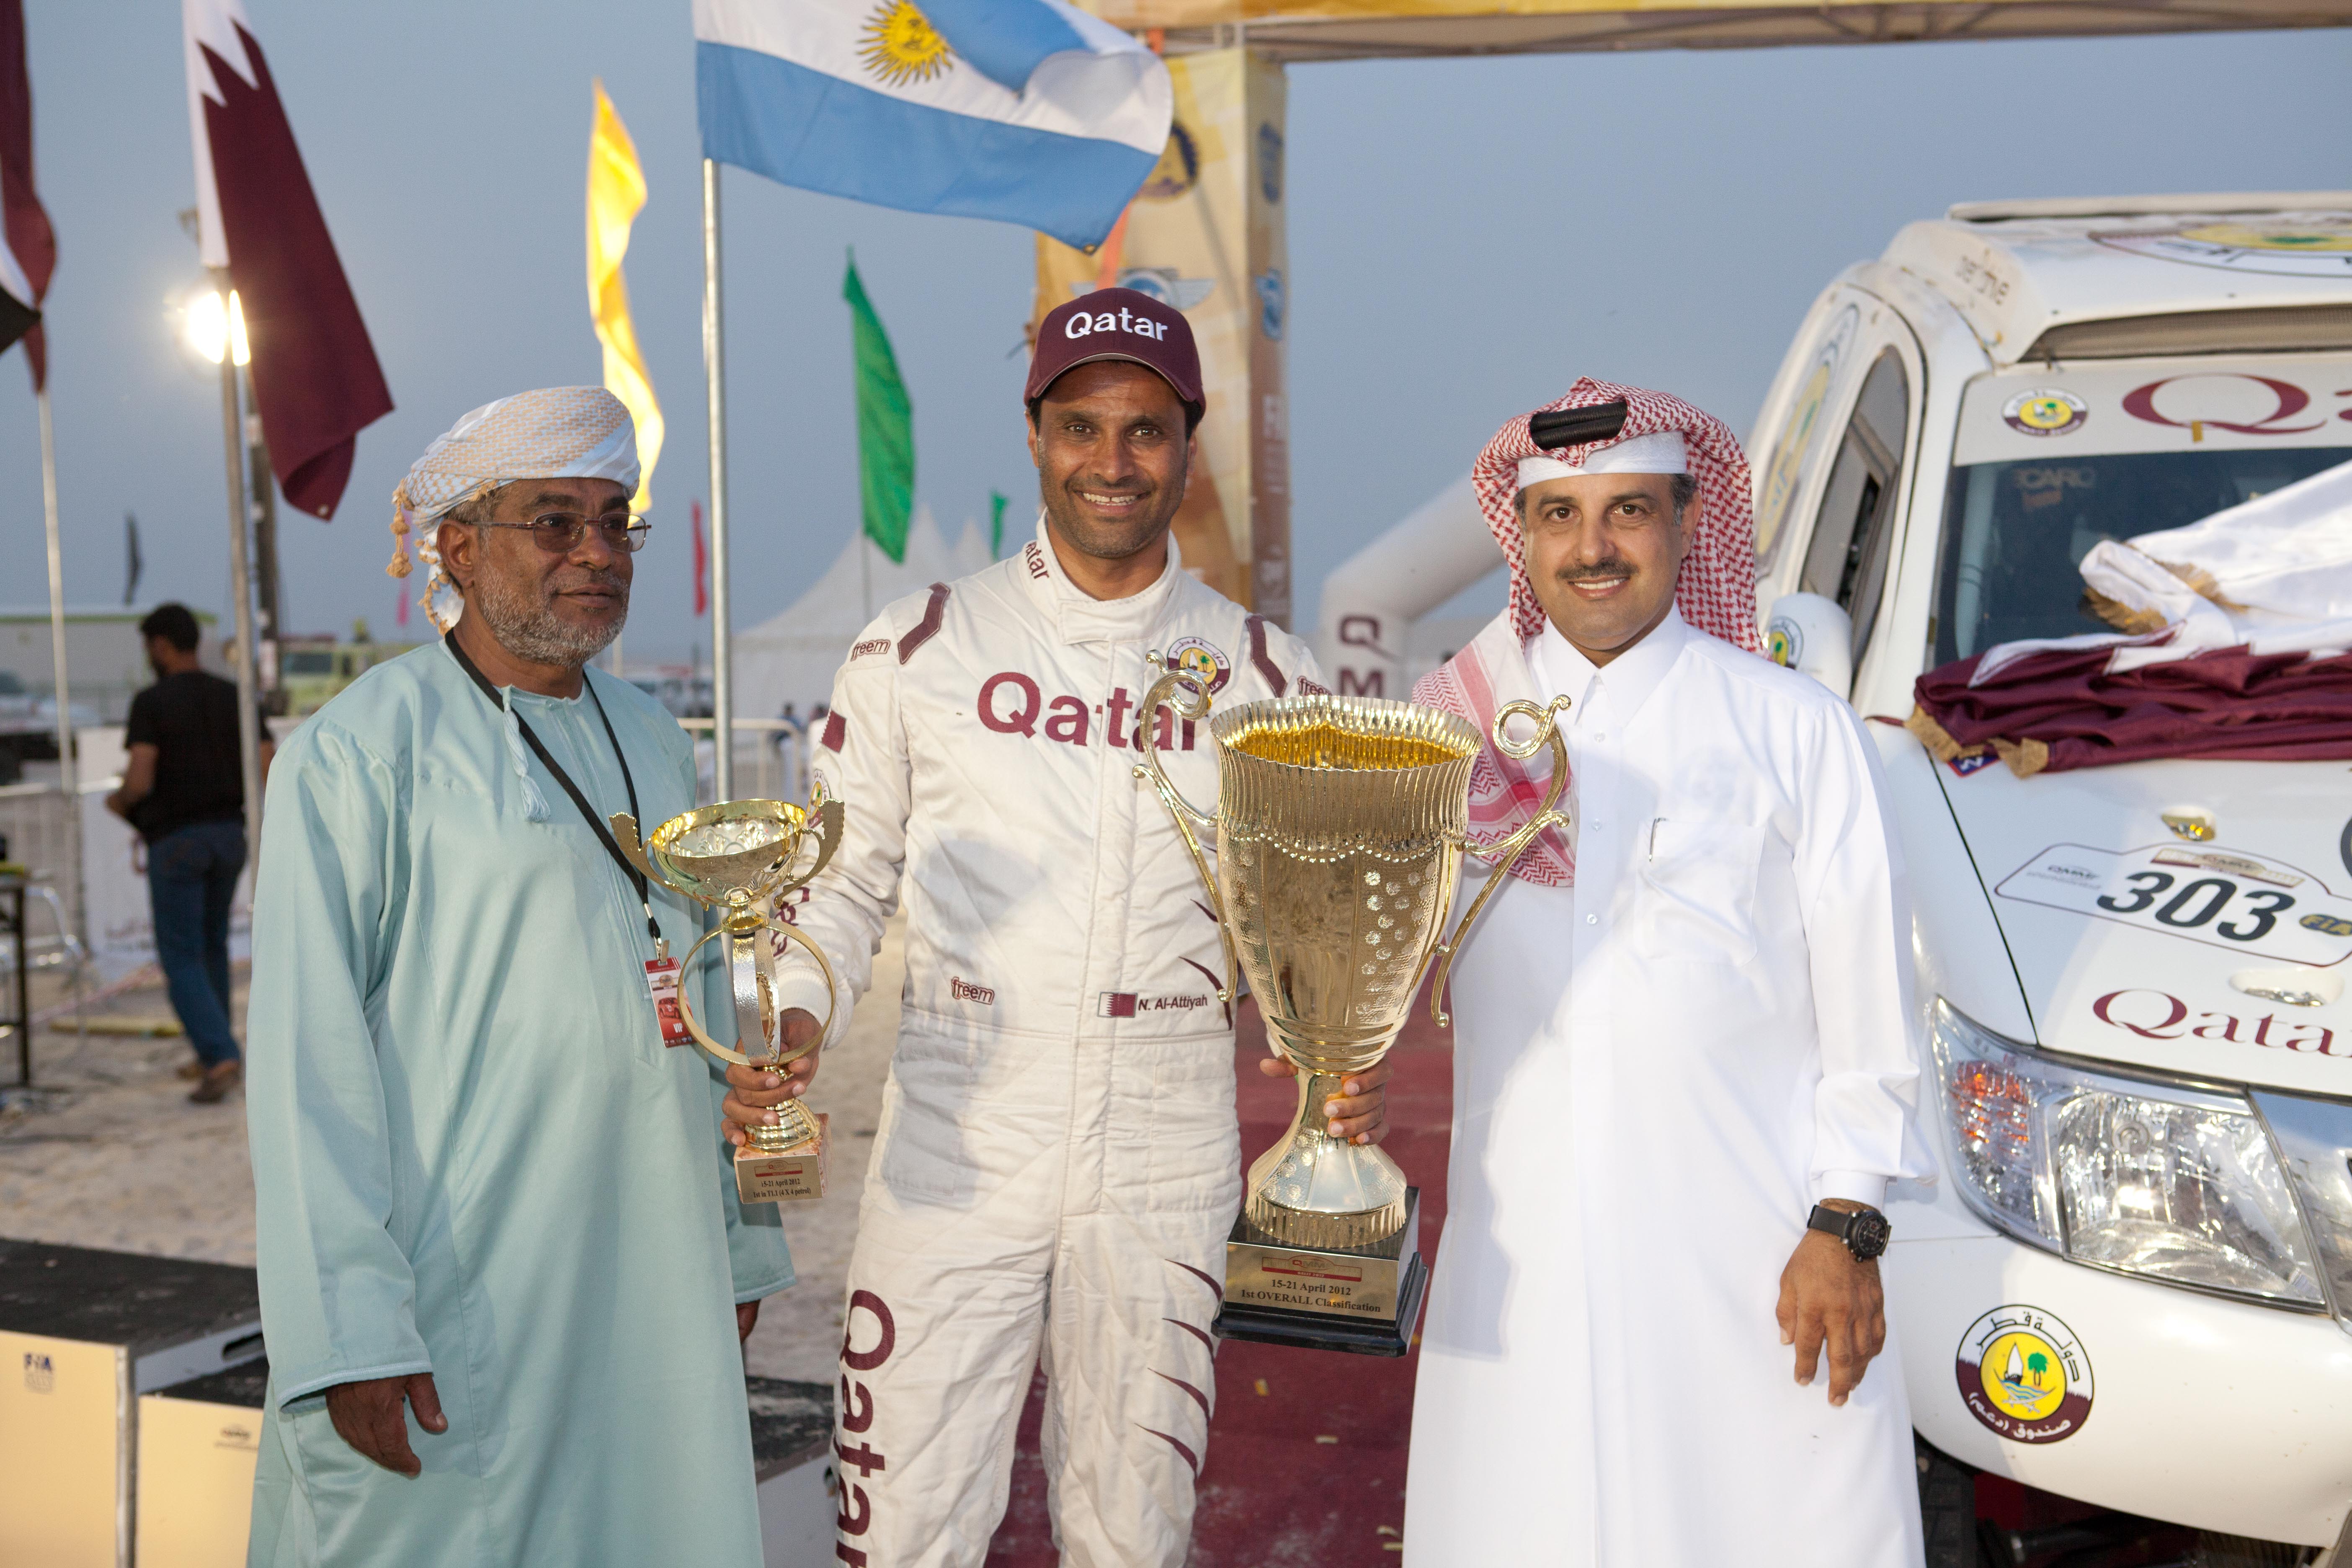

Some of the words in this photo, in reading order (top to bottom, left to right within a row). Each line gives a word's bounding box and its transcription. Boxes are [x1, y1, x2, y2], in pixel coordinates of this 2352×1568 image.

[1065, 307, 1168, 341] Qatar
[2122, 372, 2352, 436] Q
[1026, 542, 1050, 579] atar
[851, 640, 890, 661] freem
[977, 672, 1208, 751] Qatar
[2097, 872, 2296, 941] 303
[2302, 915, 2352, 936] FIA
[952, 977, 994, 1004] freem
[1138, 999, 1150, 1011] N.
[1155, 994, 1208, 1011] Al-Attiyah
[673, 1023, 683, 1033] VIP
[2093, 989, 2352, 1058] Qata
[775, 1179, 788, 1187] April
[1241, 1289, 1255, 1298] 1st
[1257, 1291, 1313, 1305] OVERALL
[1315, 1298, 1381, 1313] Classification
[1271, 1279, 1297, 1290] 15-21
[1300, 1283, 1326, 1293] April
[1329, 1285, 1351, 1296] 2012
[1976, 1311, 2032, 1355] قطر
[2034, 1316, 2080, 1382] دولة
[2013, 1419, 2071, 1440] صندوق
